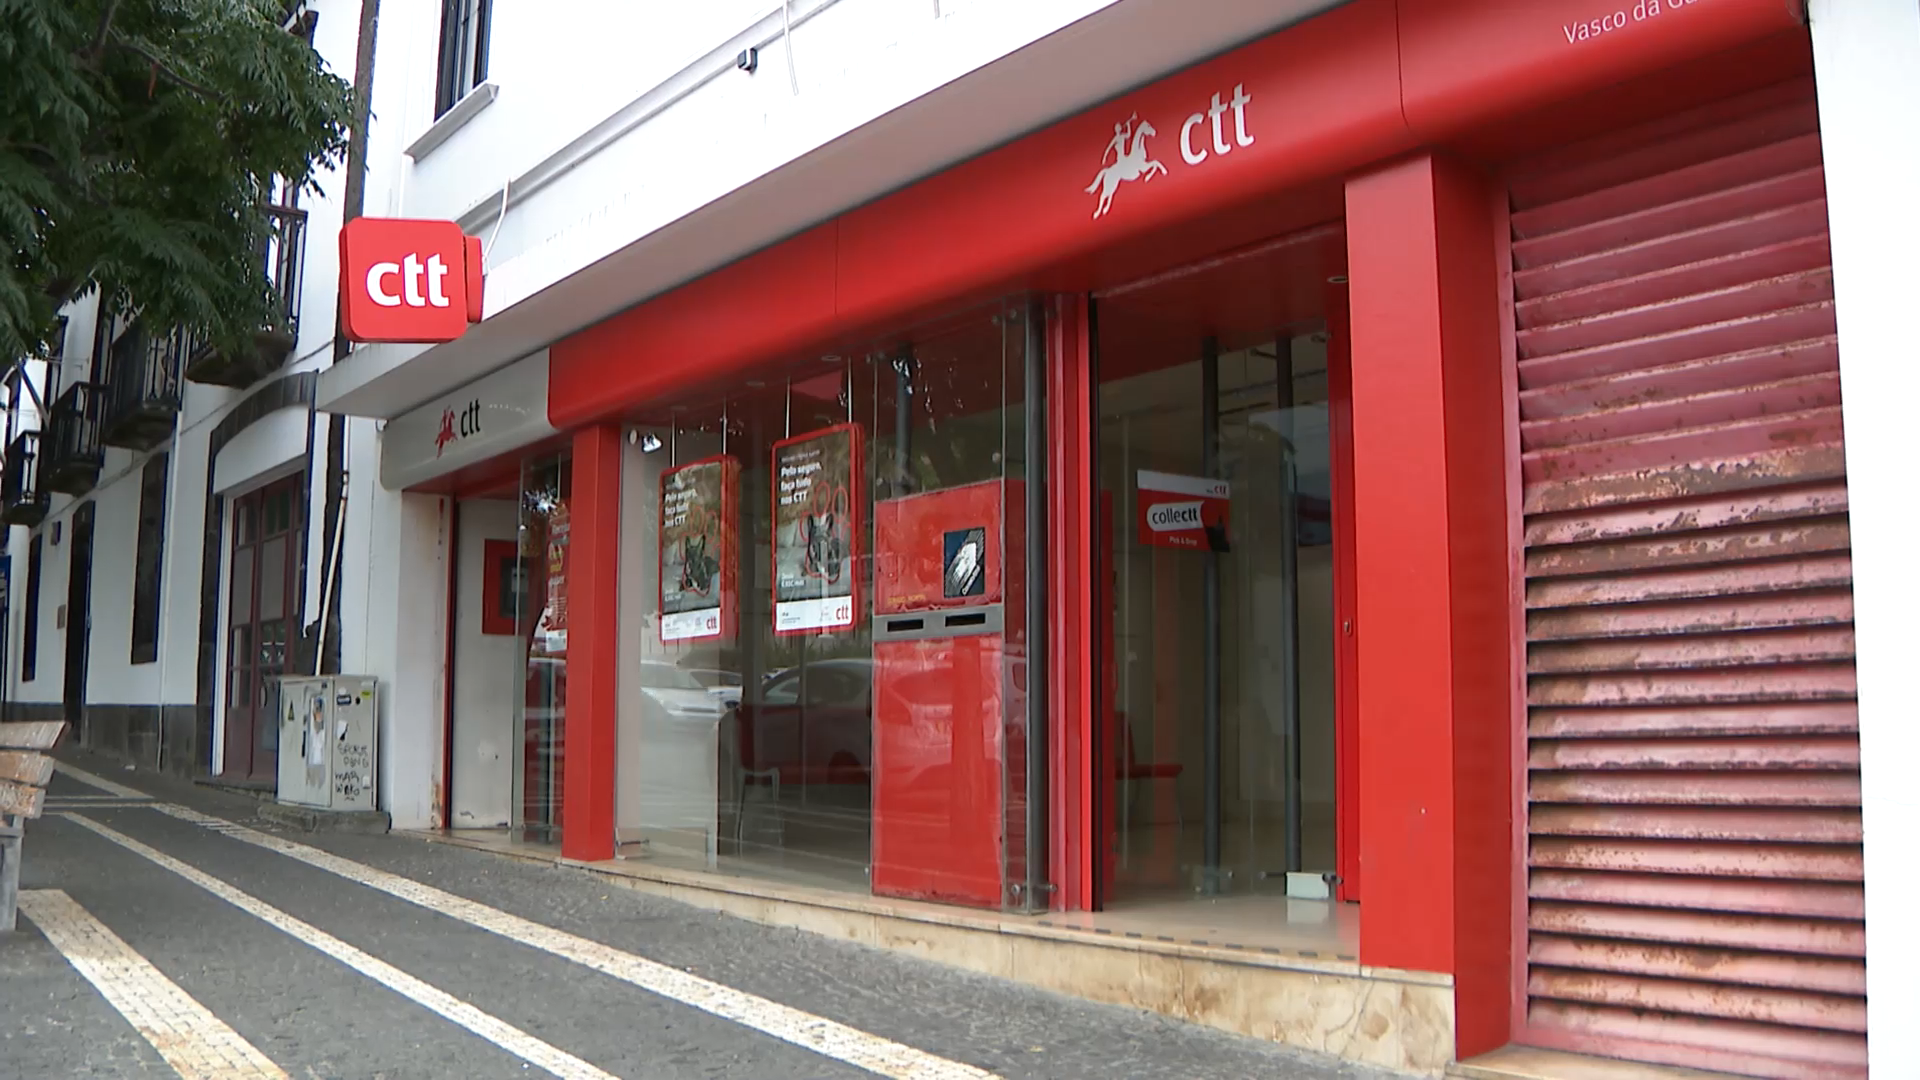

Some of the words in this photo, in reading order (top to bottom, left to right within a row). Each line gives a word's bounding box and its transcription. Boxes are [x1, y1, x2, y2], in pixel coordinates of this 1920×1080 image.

[1562, 11, 1627, 44] Vasco
[1632, 0, 1661, 21] da
[1180, 82, 1255, 166] ctt
[365, 251, 450, 308] ctt
[460, 398, 481, 438] ctt
[793, 490, 808, 503] CTT
[1152, 507, 1198, 525] collectt
[706, 616, 717, 630] ctt
[835, 604, 849, 620] ctt
